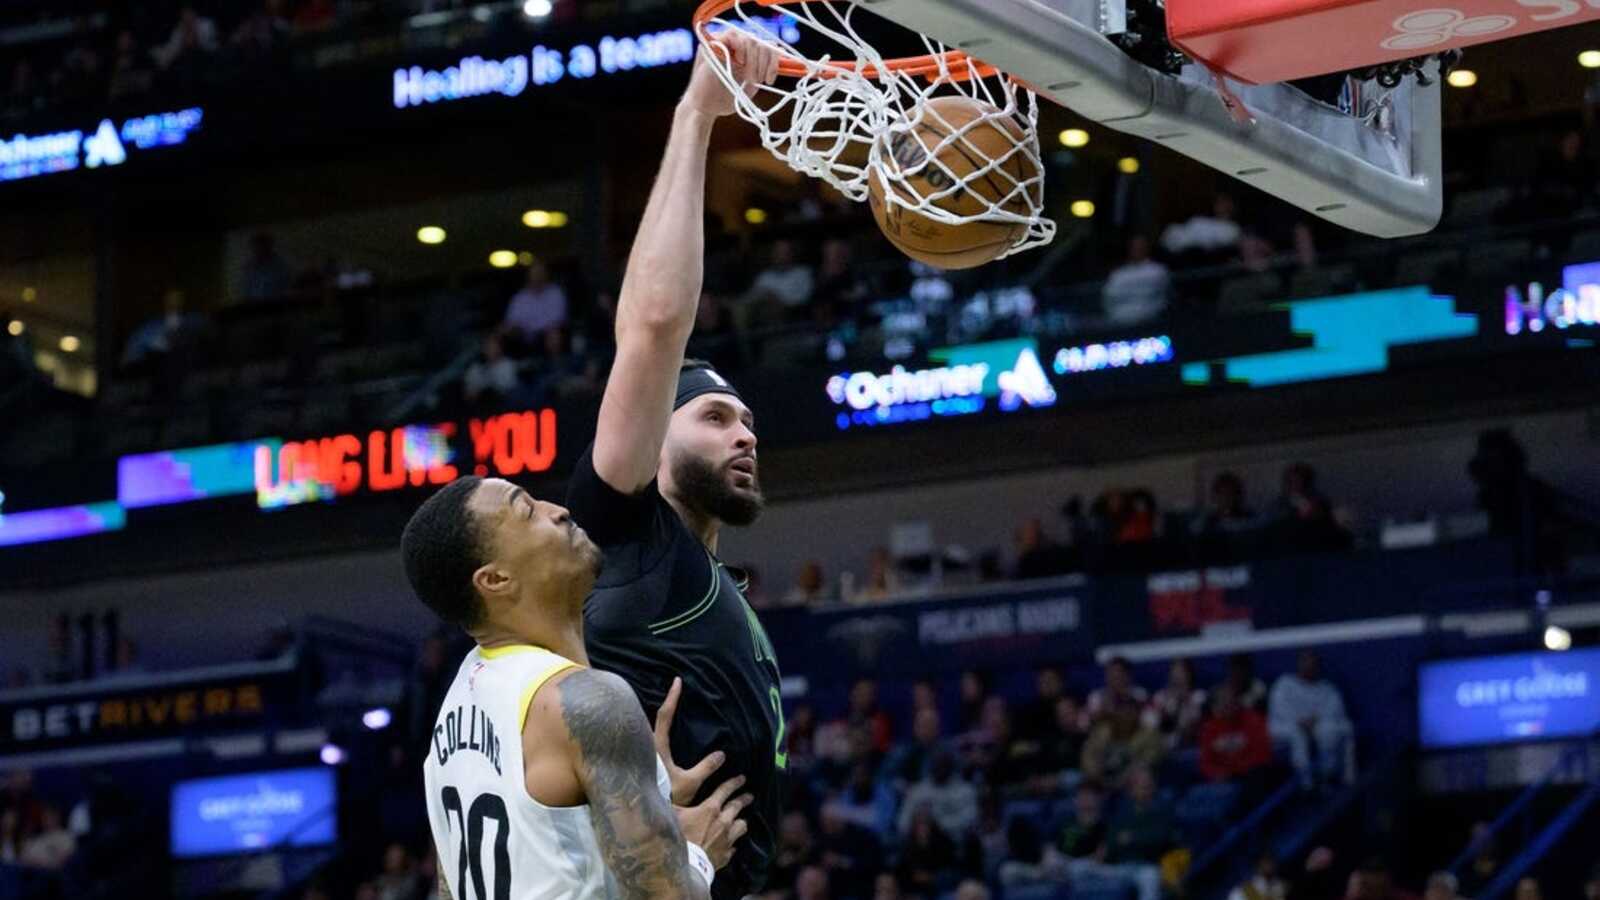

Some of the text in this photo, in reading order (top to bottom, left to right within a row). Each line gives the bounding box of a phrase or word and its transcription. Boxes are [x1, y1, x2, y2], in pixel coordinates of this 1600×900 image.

[393, 55, 529, 109] Healing
[532, 44, 565, 85] is
[567, 44, 597, 78] a
[600, 27, 693, 73] team
[254, 434, 362, 508] LONG
[468, 408, 557, 477] YOU
